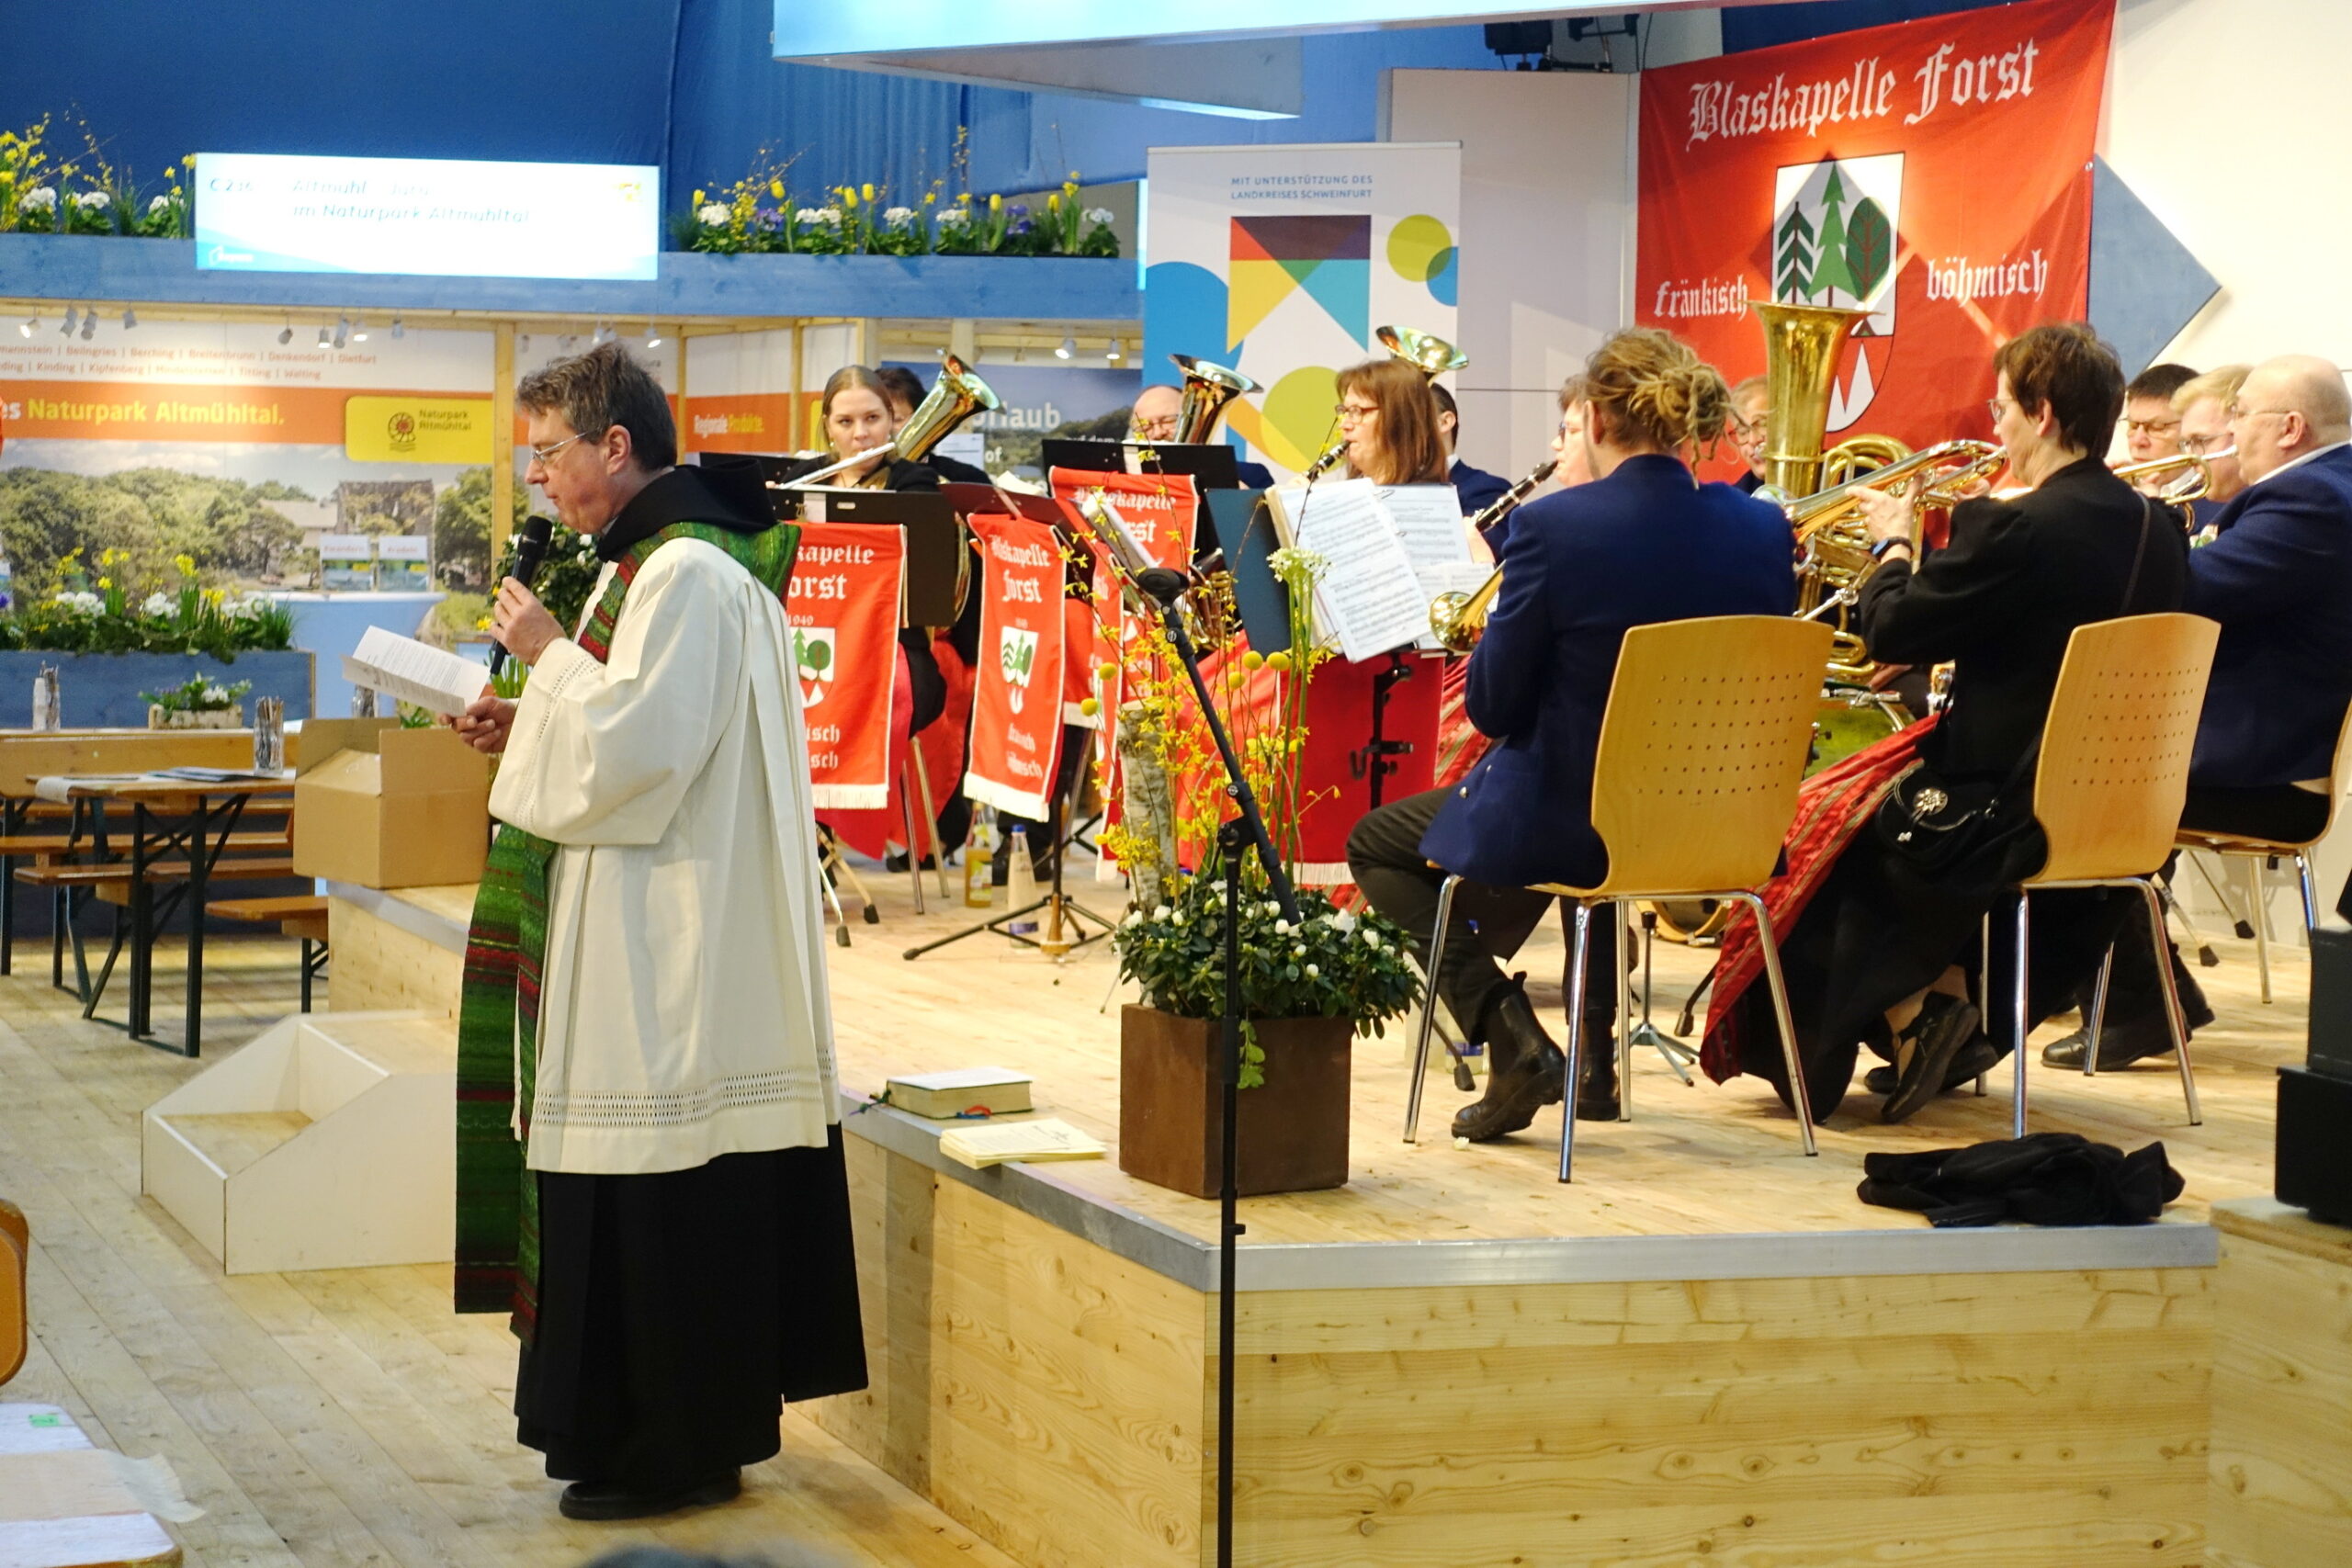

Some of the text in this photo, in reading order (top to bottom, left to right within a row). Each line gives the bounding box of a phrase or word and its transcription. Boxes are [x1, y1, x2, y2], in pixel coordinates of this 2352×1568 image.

[1686, 37, 2040, 152] Blaskapelle Forst
[1231, 175, 1373, 186] MIT UNTERSTÜTZUNG DES
[1231, 189, 1372, 199] LANDKREISES SCHWEINFURT
[1927, 249, 2049, 301] böhmisch
[1653, 275, 1748, 320] fränkisch
[28, 398, 147, 425] Naturpark
[419, 410, 469, 421] Naturpark
[788, 573, 847, 600] orst
